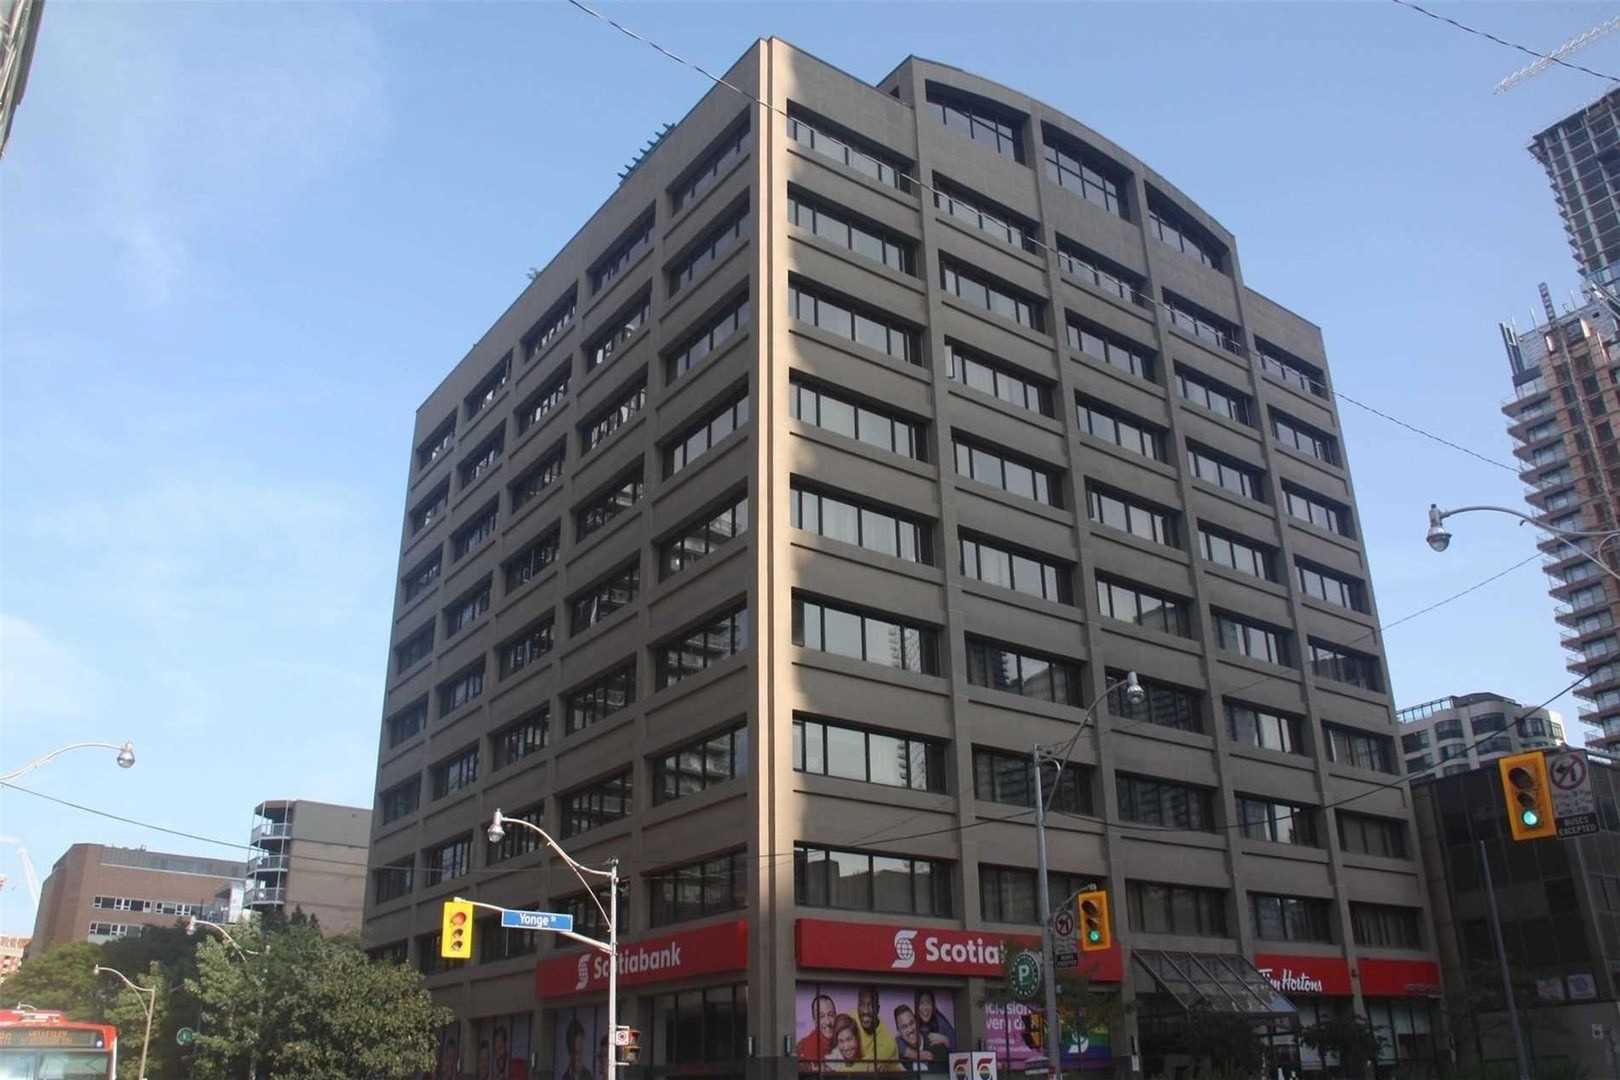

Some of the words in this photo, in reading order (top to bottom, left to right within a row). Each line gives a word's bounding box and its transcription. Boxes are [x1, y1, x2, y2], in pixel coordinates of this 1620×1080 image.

[520, 912, 549, 927] Yonge
[593, 941, 681, 979] Sctiabank
[1018, 964, 1030, 983] P
[1282, 968, 1322, 992] Hortons
